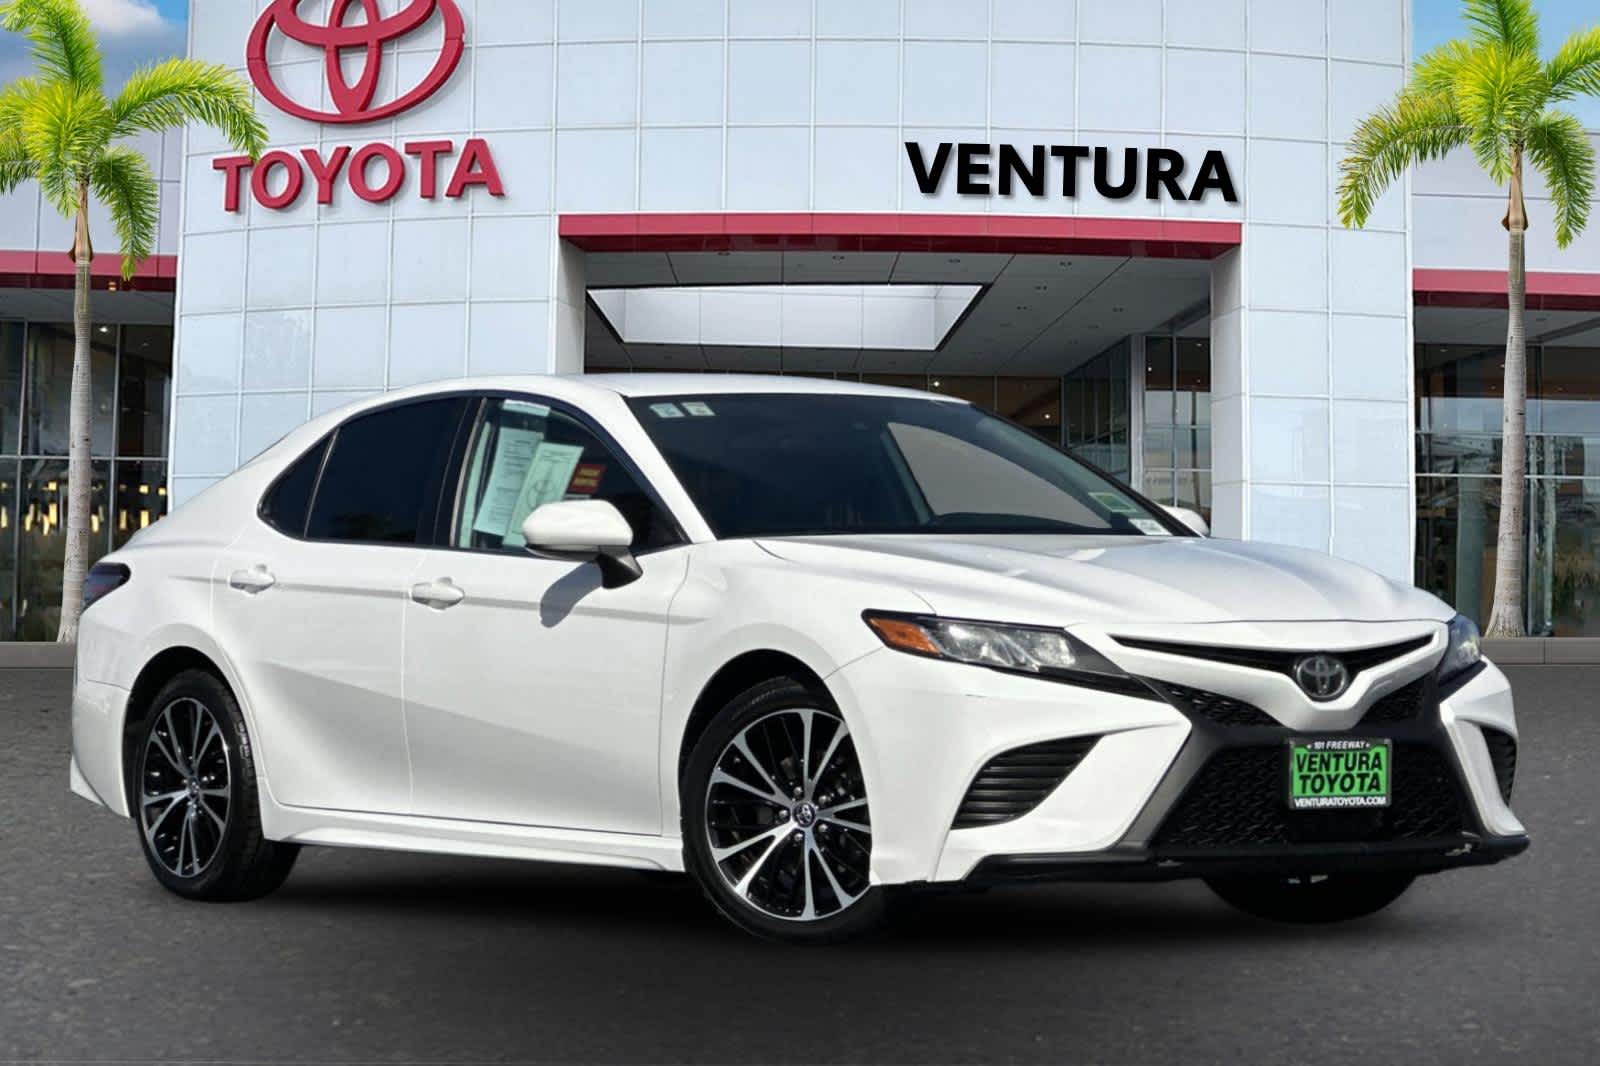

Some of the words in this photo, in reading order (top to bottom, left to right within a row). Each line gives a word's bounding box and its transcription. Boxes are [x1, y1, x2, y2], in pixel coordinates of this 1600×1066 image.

[213, 138, 505, 212] TOYOTA
[904, 141, 1241, 203] VENTURA
[1314, 741, 1325, 750] 101
[1326, 740, 1365, 750] FREEWAY
[1296, 752, 1383, 773] VENTURA
[1299, 772, 1381, 794] TOYOTA
[1294, 796, 1386, 808] VENTURATOYOTA.COM
